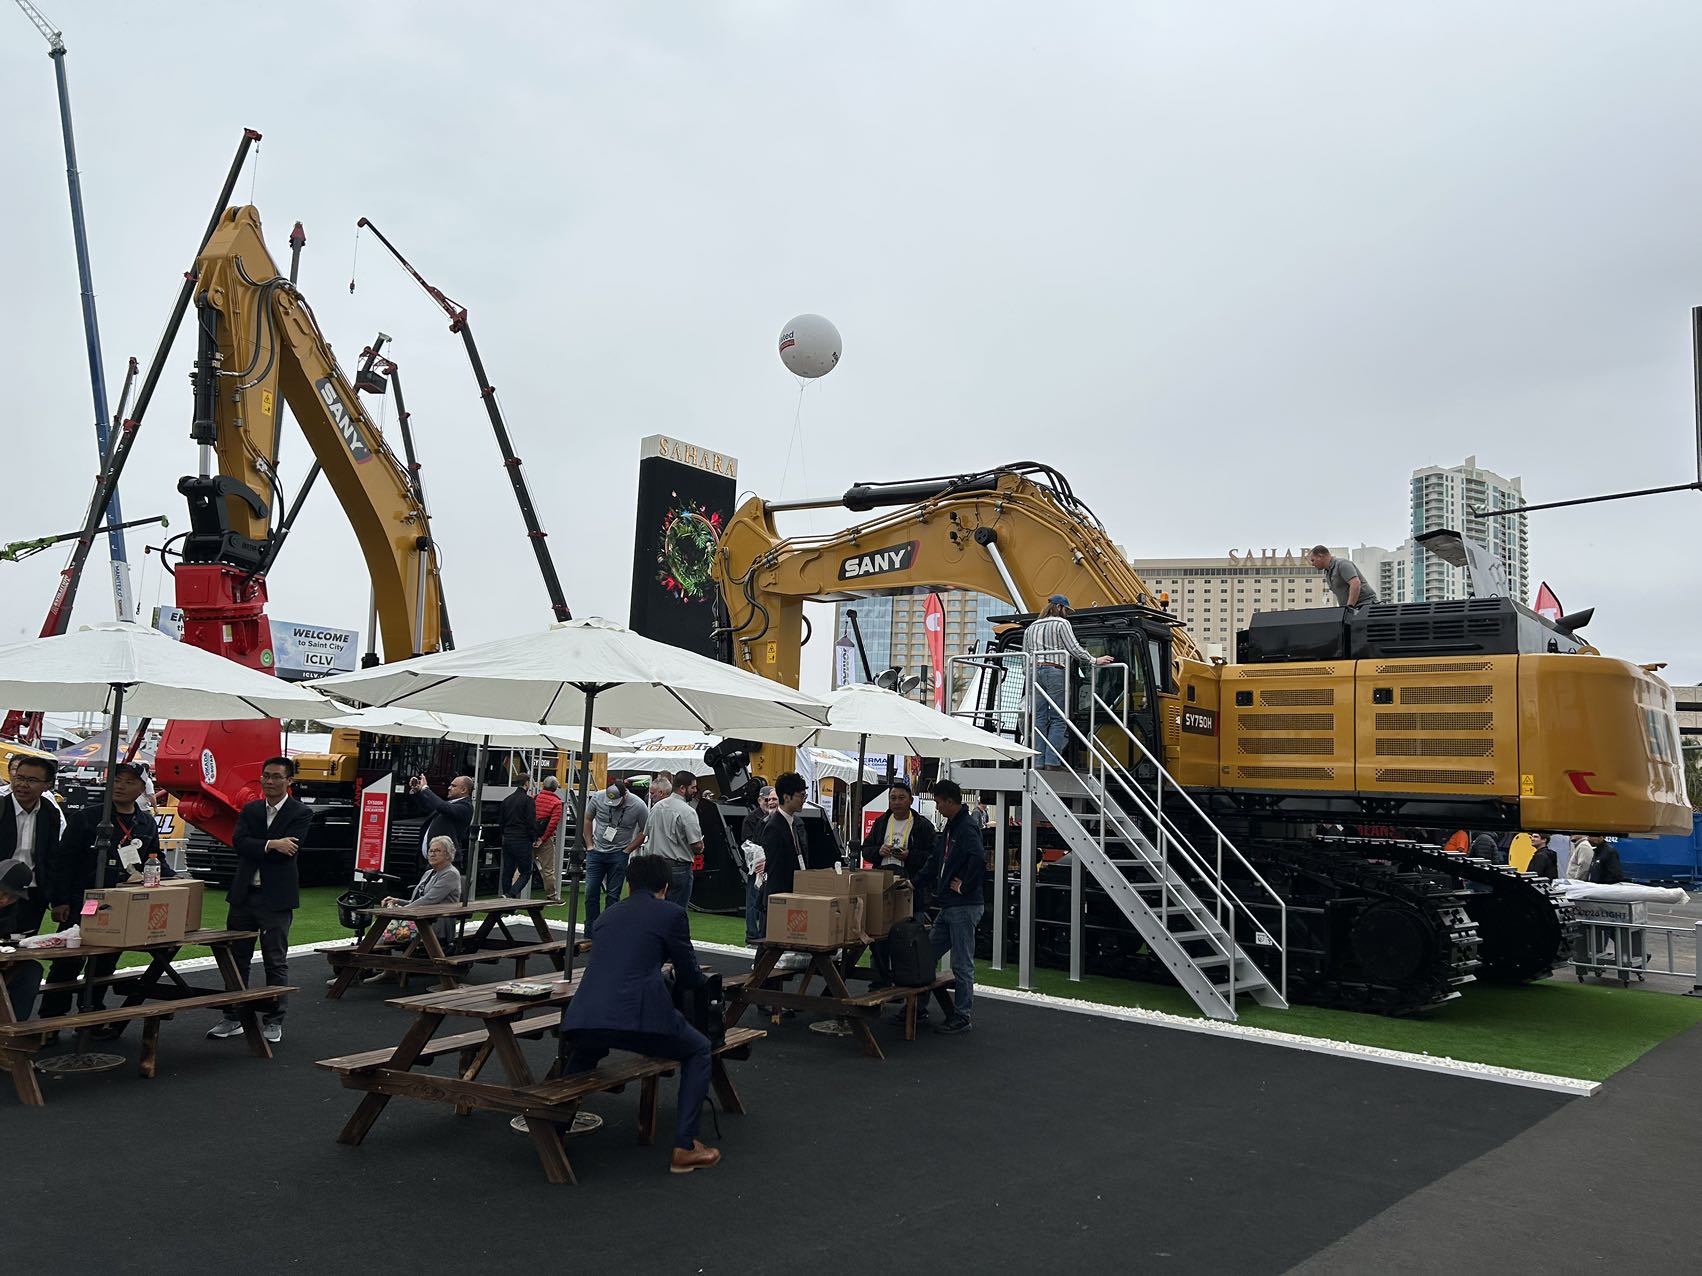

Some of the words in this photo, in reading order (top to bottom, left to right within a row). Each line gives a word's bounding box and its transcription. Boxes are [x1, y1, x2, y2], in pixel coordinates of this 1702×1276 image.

[320, 382, 363, 451] SANY
[659, 437, 737, 478] SAHARA
[844, 549, 906, 577] SANY
[1228, 547, 1312, 567] SAHAR
[293, 628, 350, 643] WELCOME
[308, 640, 328, 649] Saint
[329, 642, 344, 652] City
[305, 653, 333, 666] ICLV
[1185, 713, 1212, 729] SY750H
[1601, 910, 1627, 920] LIGHT
